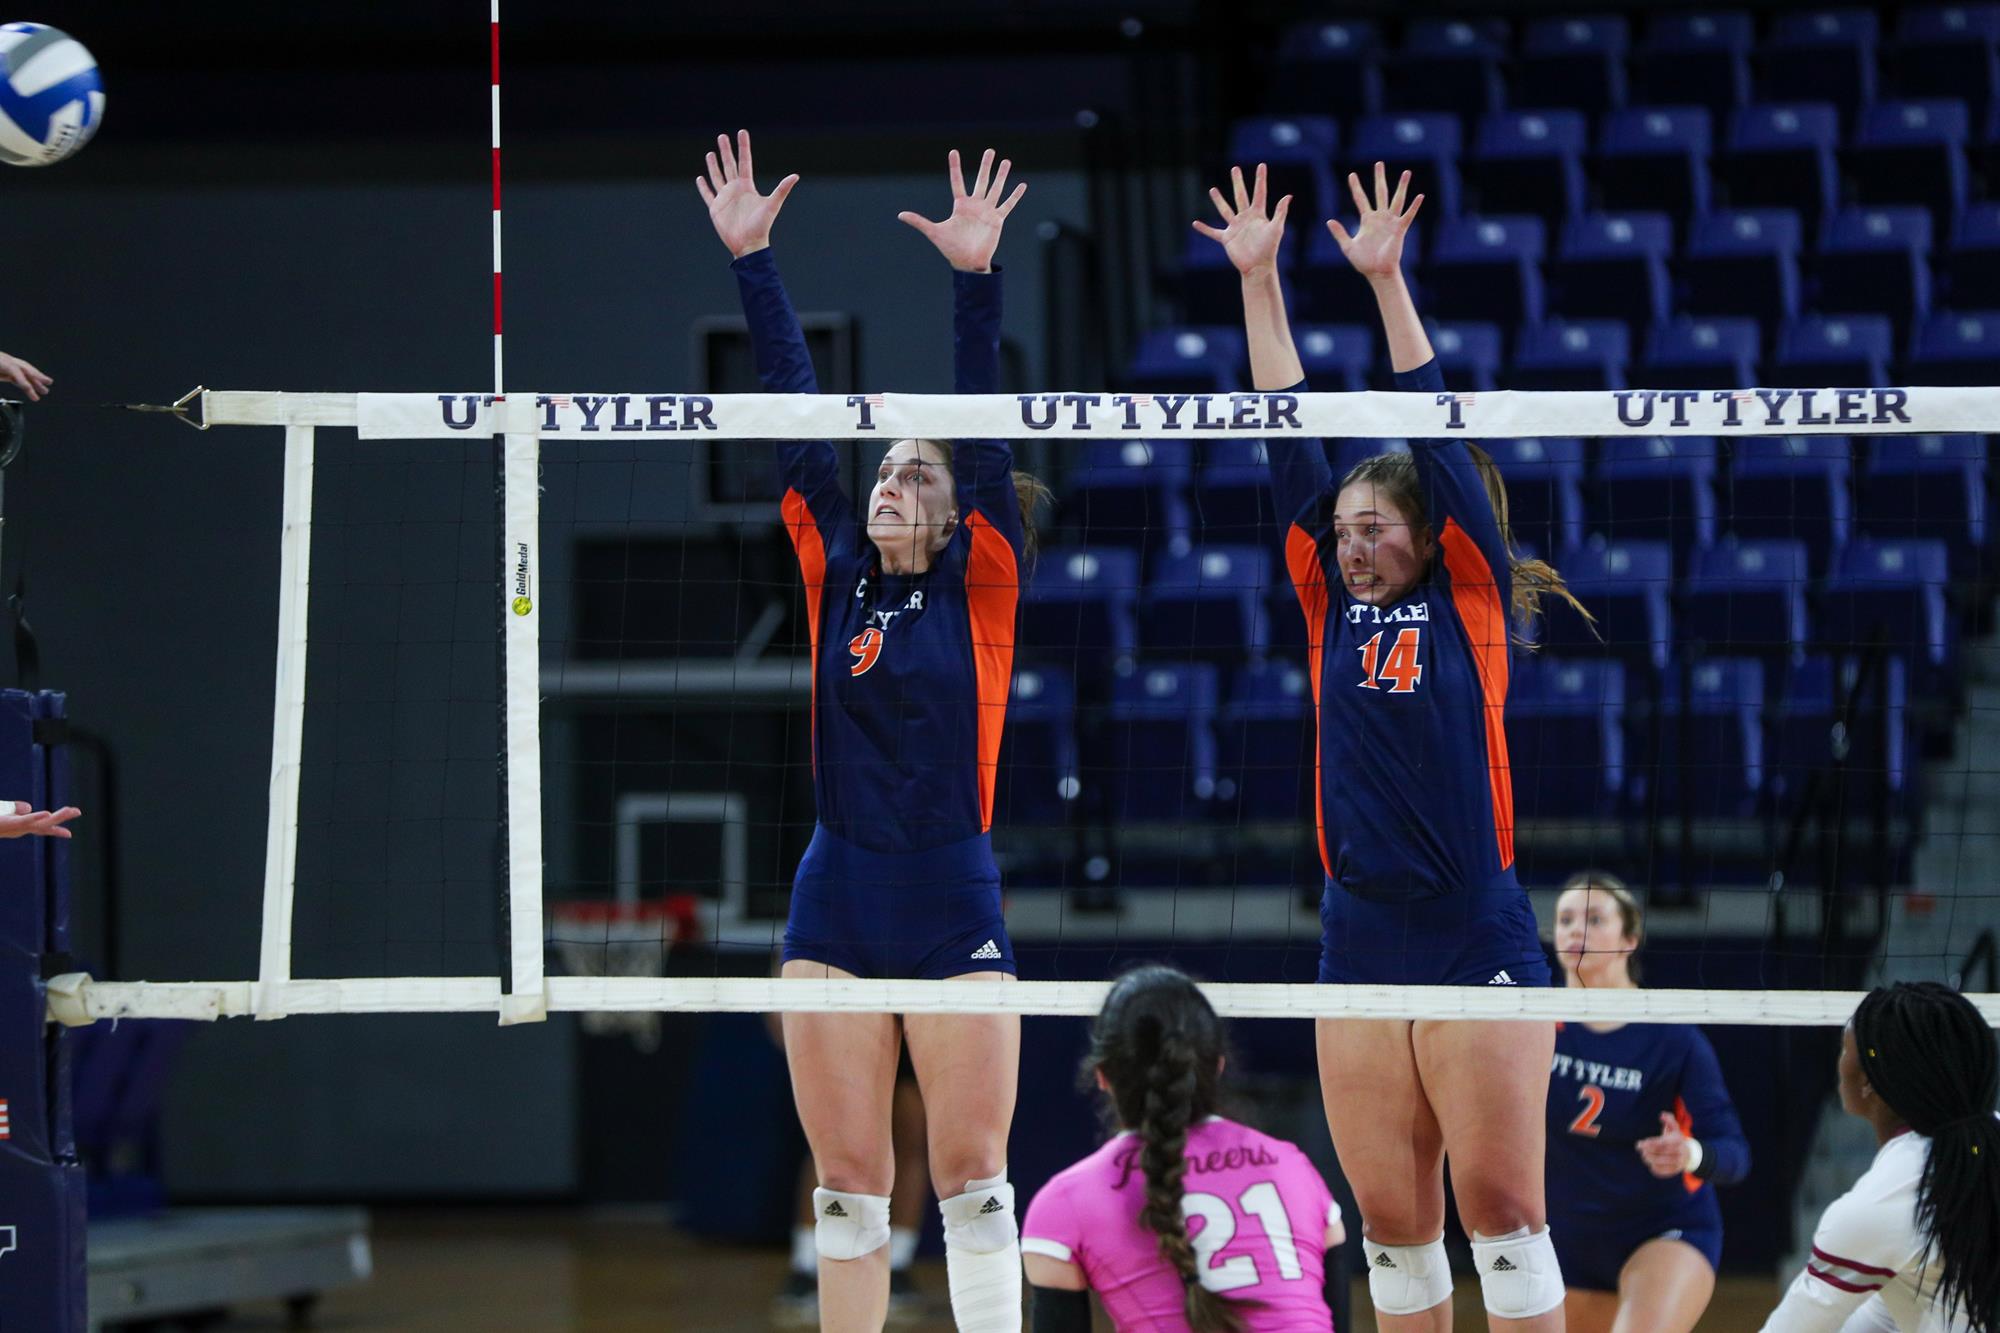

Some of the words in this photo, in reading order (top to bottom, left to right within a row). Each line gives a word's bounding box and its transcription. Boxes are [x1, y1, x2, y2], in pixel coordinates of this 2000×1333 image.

[536, 395, 718, 431] TYLER
[1017, 394, 1101, 430] UT
[1112, 394, 1303, 430] TYLER
[1613, 389, 1698, 427] UT
[1713, 387, 1911, 426] TYLER
[516, 542, 528, 596] GoldMedal
[848, 627, 884, 677] 9
[1356, 627, 1423, 693] 14
[1568, 1084, 1605, 1138] 2
[1111, 1143, 1279, 1190] Pneers
[1180, 1179, 1304, 1294] 21
